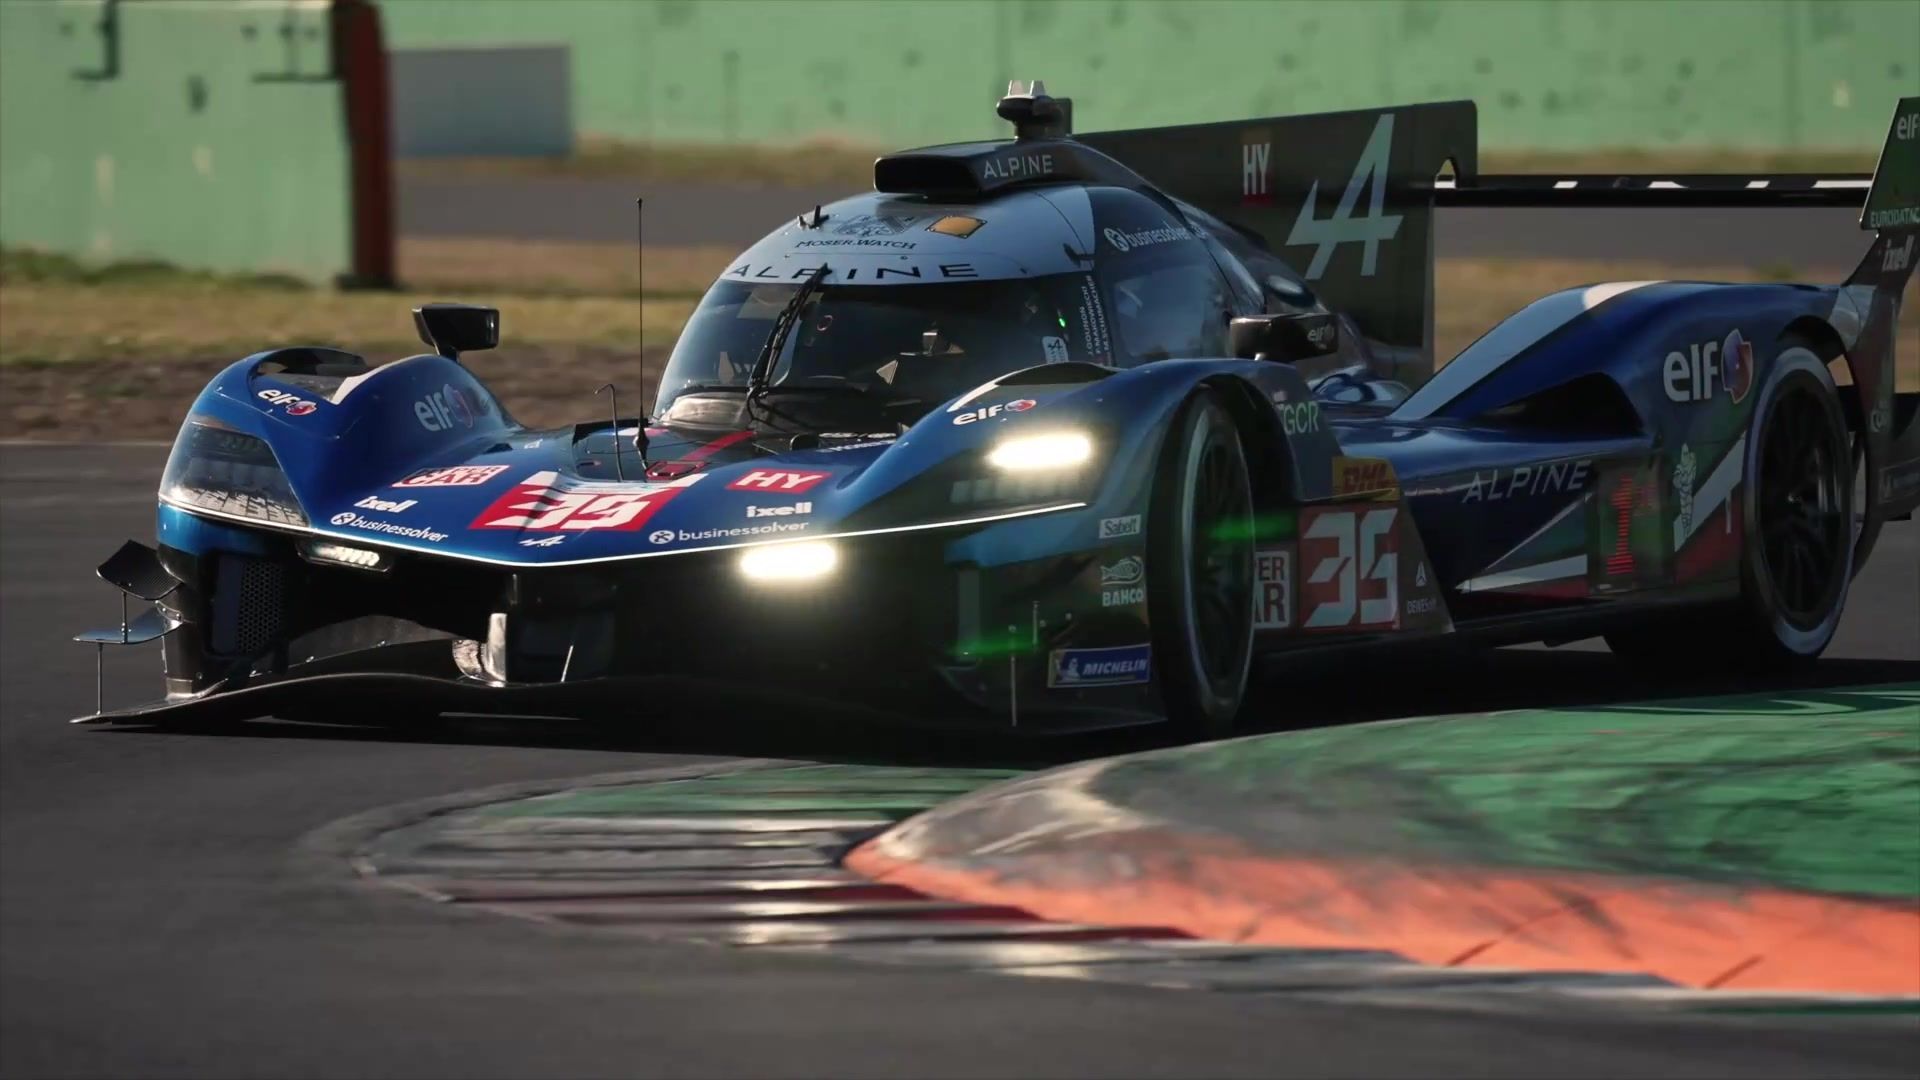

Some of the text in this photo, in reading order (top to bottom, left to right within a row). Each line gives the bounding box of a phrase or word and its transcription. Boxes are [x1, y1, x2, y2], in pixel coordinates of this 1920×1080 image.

[1896, 114, 1920, 141] elf
[983, 154, 1054, 179] ALPINE
[1243, 143, 1271, 195] HY
[795, 239, 918, 252] MOSER.WATCH
[1881, 235, 1915, 272] ixell
[727, 263, 979, 280] ALPINE
[1663, 341, 1719, 402] elf
[257, 389, 302, 405] elf
[414, 391, 454, 432] elf
[953, 404, 1004, 425] elf
[402, 472, 489, 485] CAR
[735, 471, 824, 489] HY
[1343, 463, 1394, 492] DHL
[1462, 459, 1592, 504] ALPINE
[354, 495, 419, 513] ixell
[484, 487, 681, 530] 35
[746, 501, 813, 518] ixell
[351, 515, 449, 543] businessolver
[678, 521, 810, 541] businessolver
[1104, 517, 1137, 537] Sabelt
[1303, 508, 1399, 628] 35
[1102, 588, 1144, 607] BAHCO
[1082, 658, 1148, 676] MICHELIN
